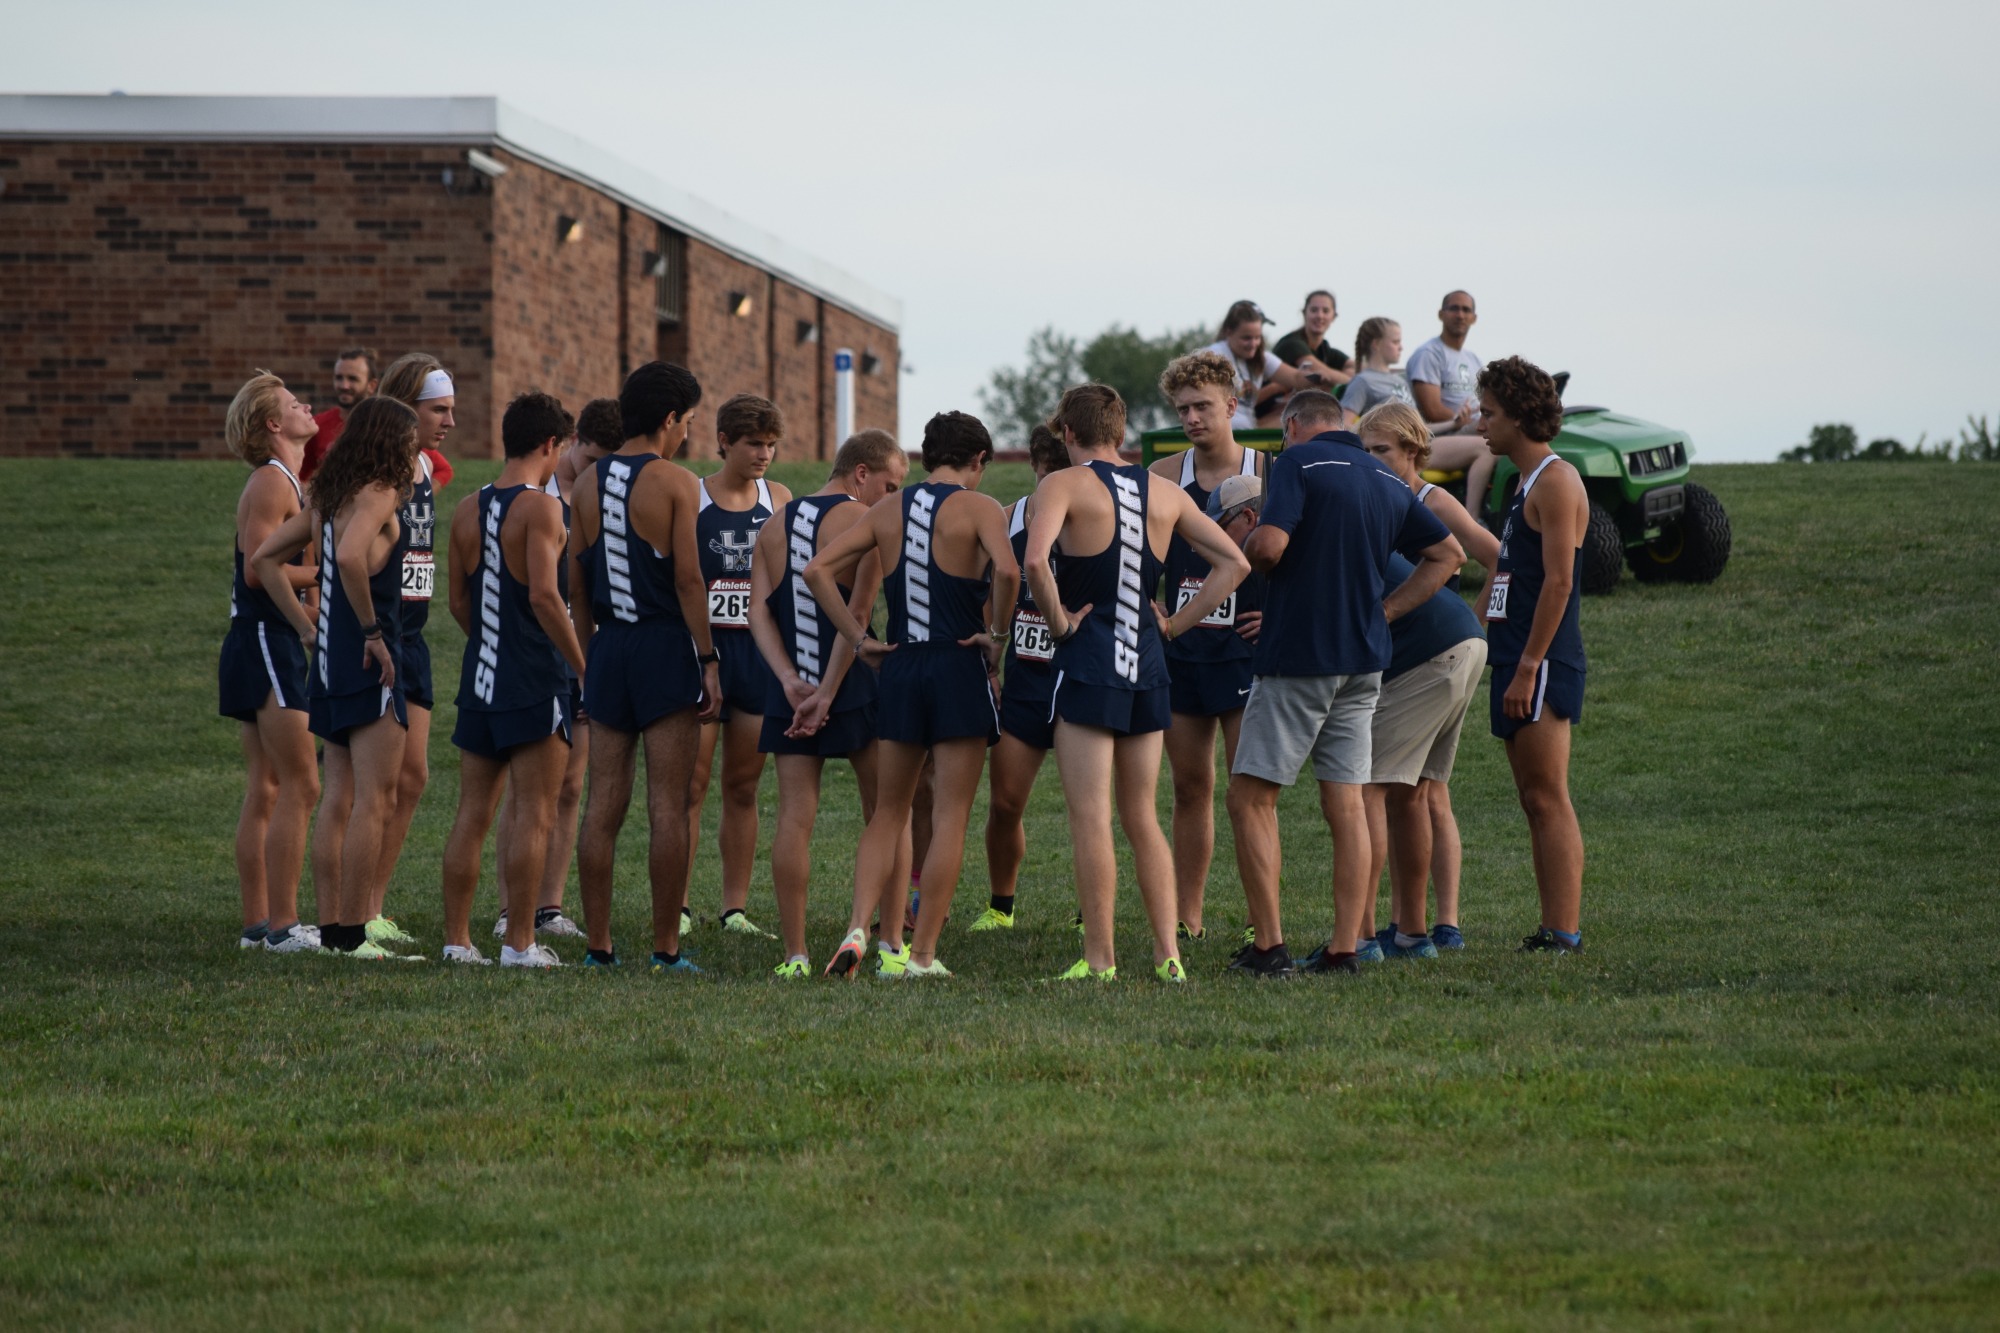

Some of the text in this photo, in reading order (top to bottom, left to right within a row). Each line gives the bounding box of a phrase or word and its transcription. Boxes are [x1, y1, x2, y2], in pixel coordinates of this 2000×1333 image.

[474, 496, 501, 705] HAWKS
[711, 580, 751, 590] Athletic
[1111, 471, 1144, 684] HAWKS
[1488, 588, 1505, 611] 58
